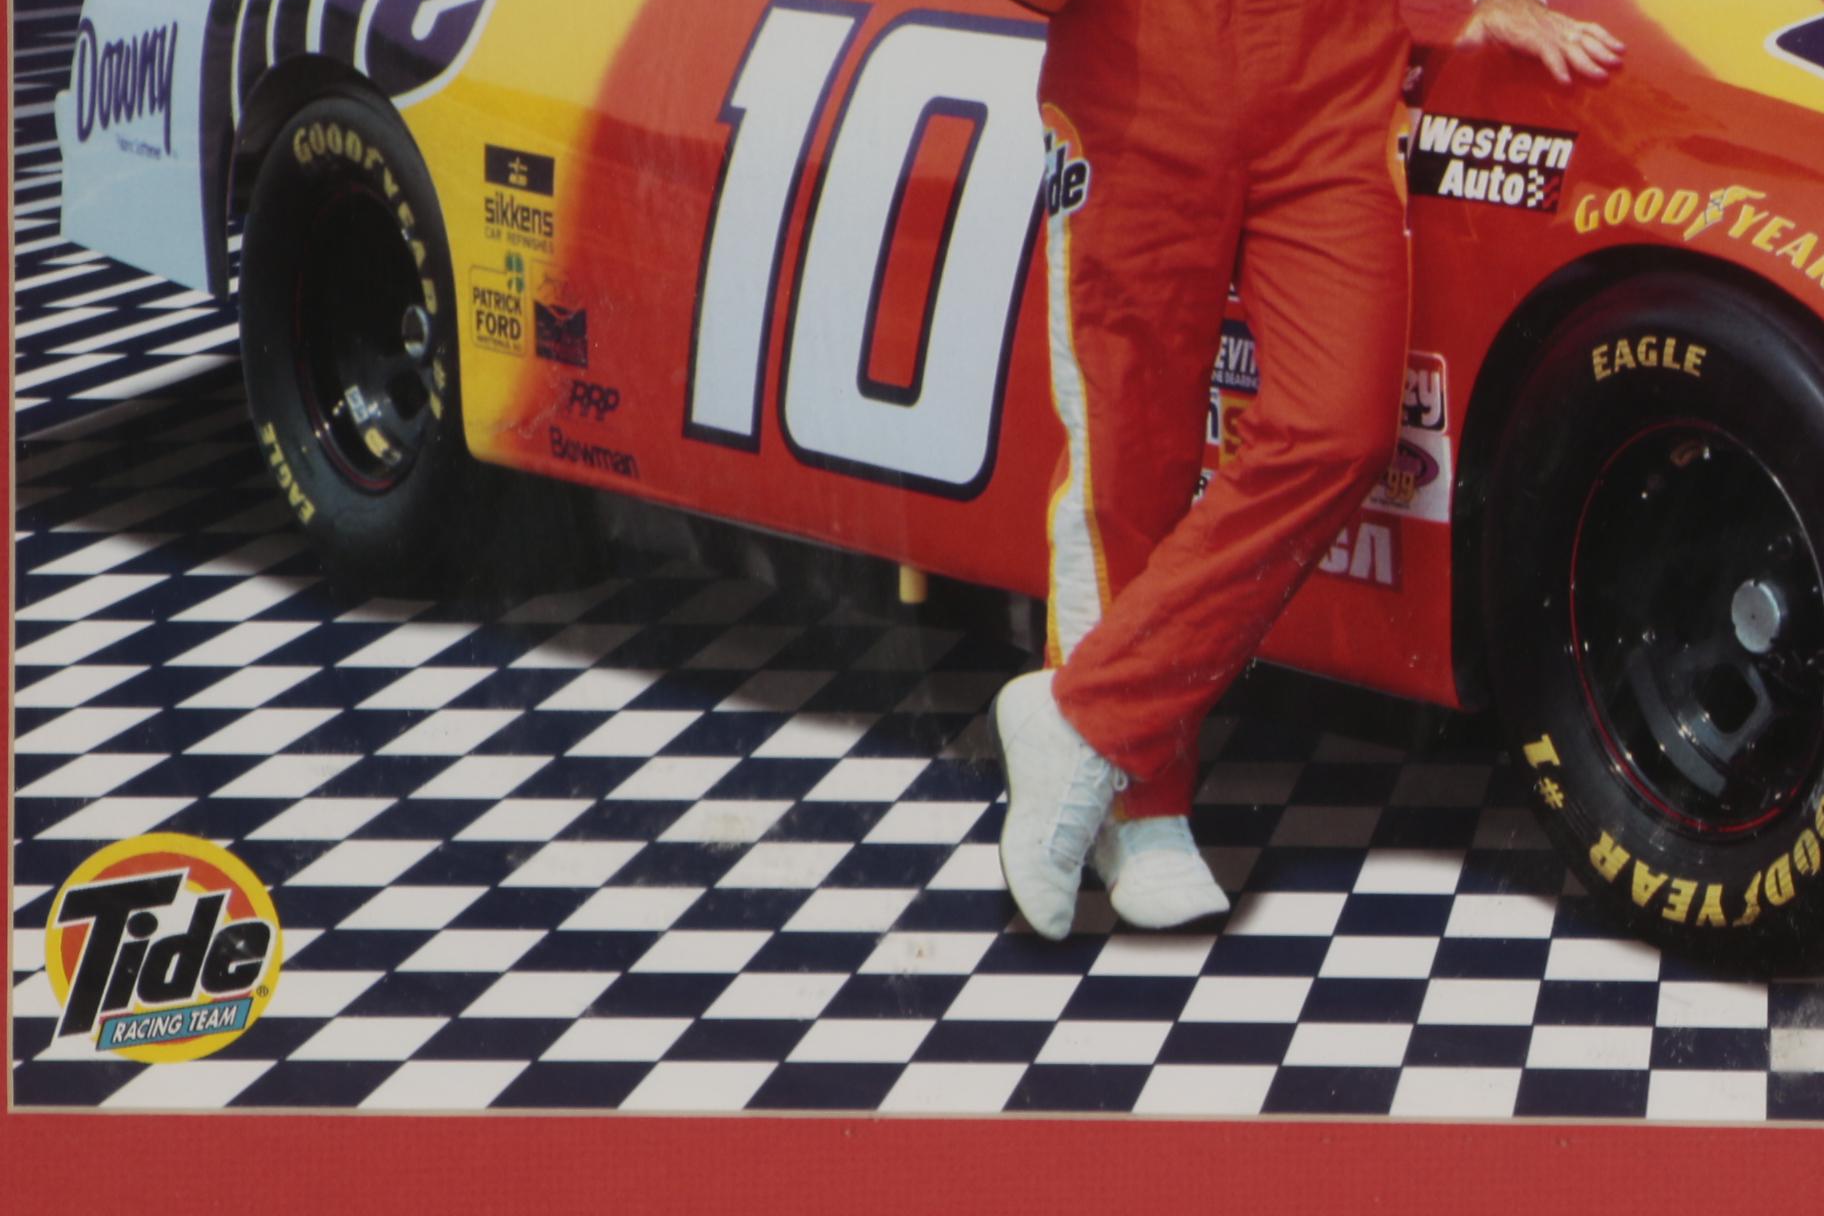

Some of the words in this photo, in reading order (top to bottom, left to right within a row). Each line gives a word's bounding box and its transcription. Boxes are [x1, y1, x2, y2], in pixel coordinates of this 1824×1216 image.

[77, 17, 178, 155] Downy
[1418, 114, 1575, 170] Western
[1437, 158, 1526, 206] Auto
[484, 191, 554, 238] sikkens
[473, 286, 523, 315] PATRICK
[475, 310, 523, 341] FORD
[1591, 336, 1706, 381] EAGLE
[1523, 733, 1566, 810] #1
[56, 871, 272, 1039] Tide
[112, 1013, 183, 1045] RACING
[189, 1005, 237, 1031] TEAM
